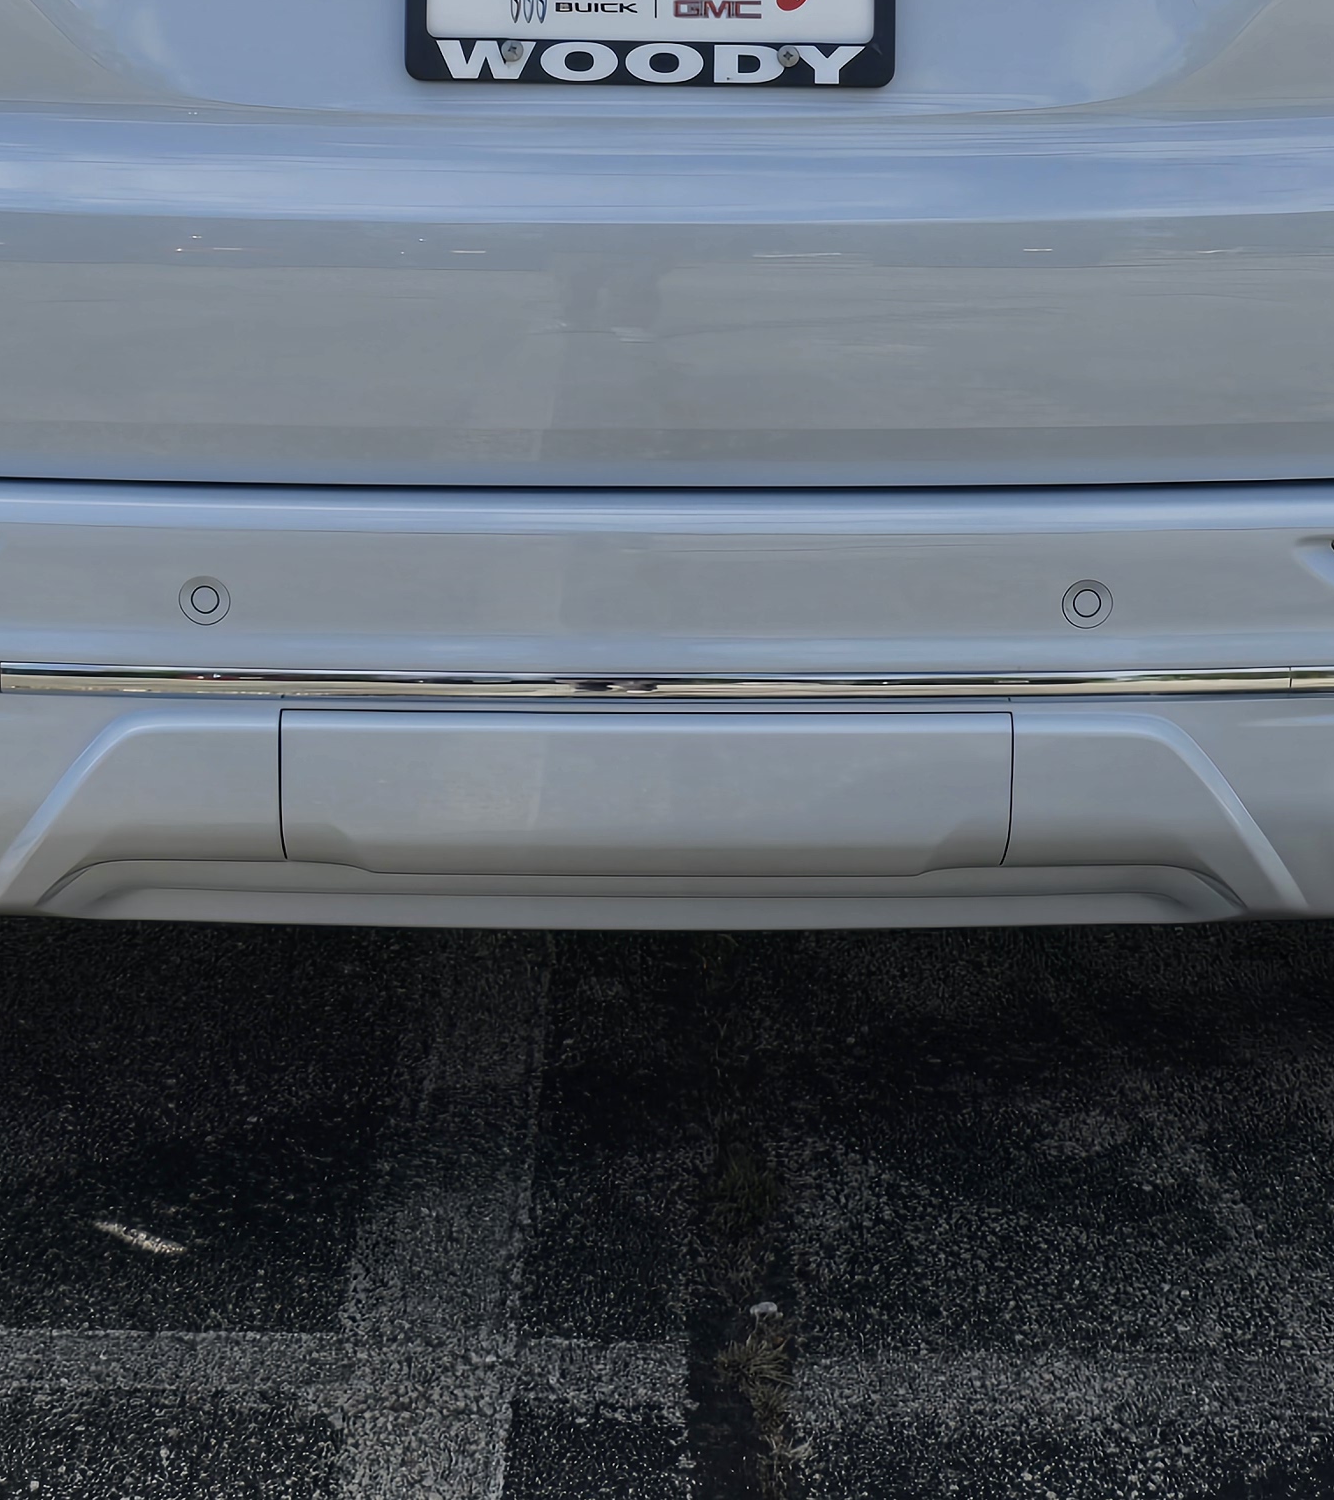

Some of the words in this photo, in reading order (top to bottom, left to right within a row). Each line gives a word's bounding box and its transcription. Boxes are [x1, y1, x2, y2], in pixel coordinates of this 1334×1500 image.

[555, 1, 638, 14] BUICK
[673, 0, 762, 19] GMC
[435, 40, 866, 85] WOODY
